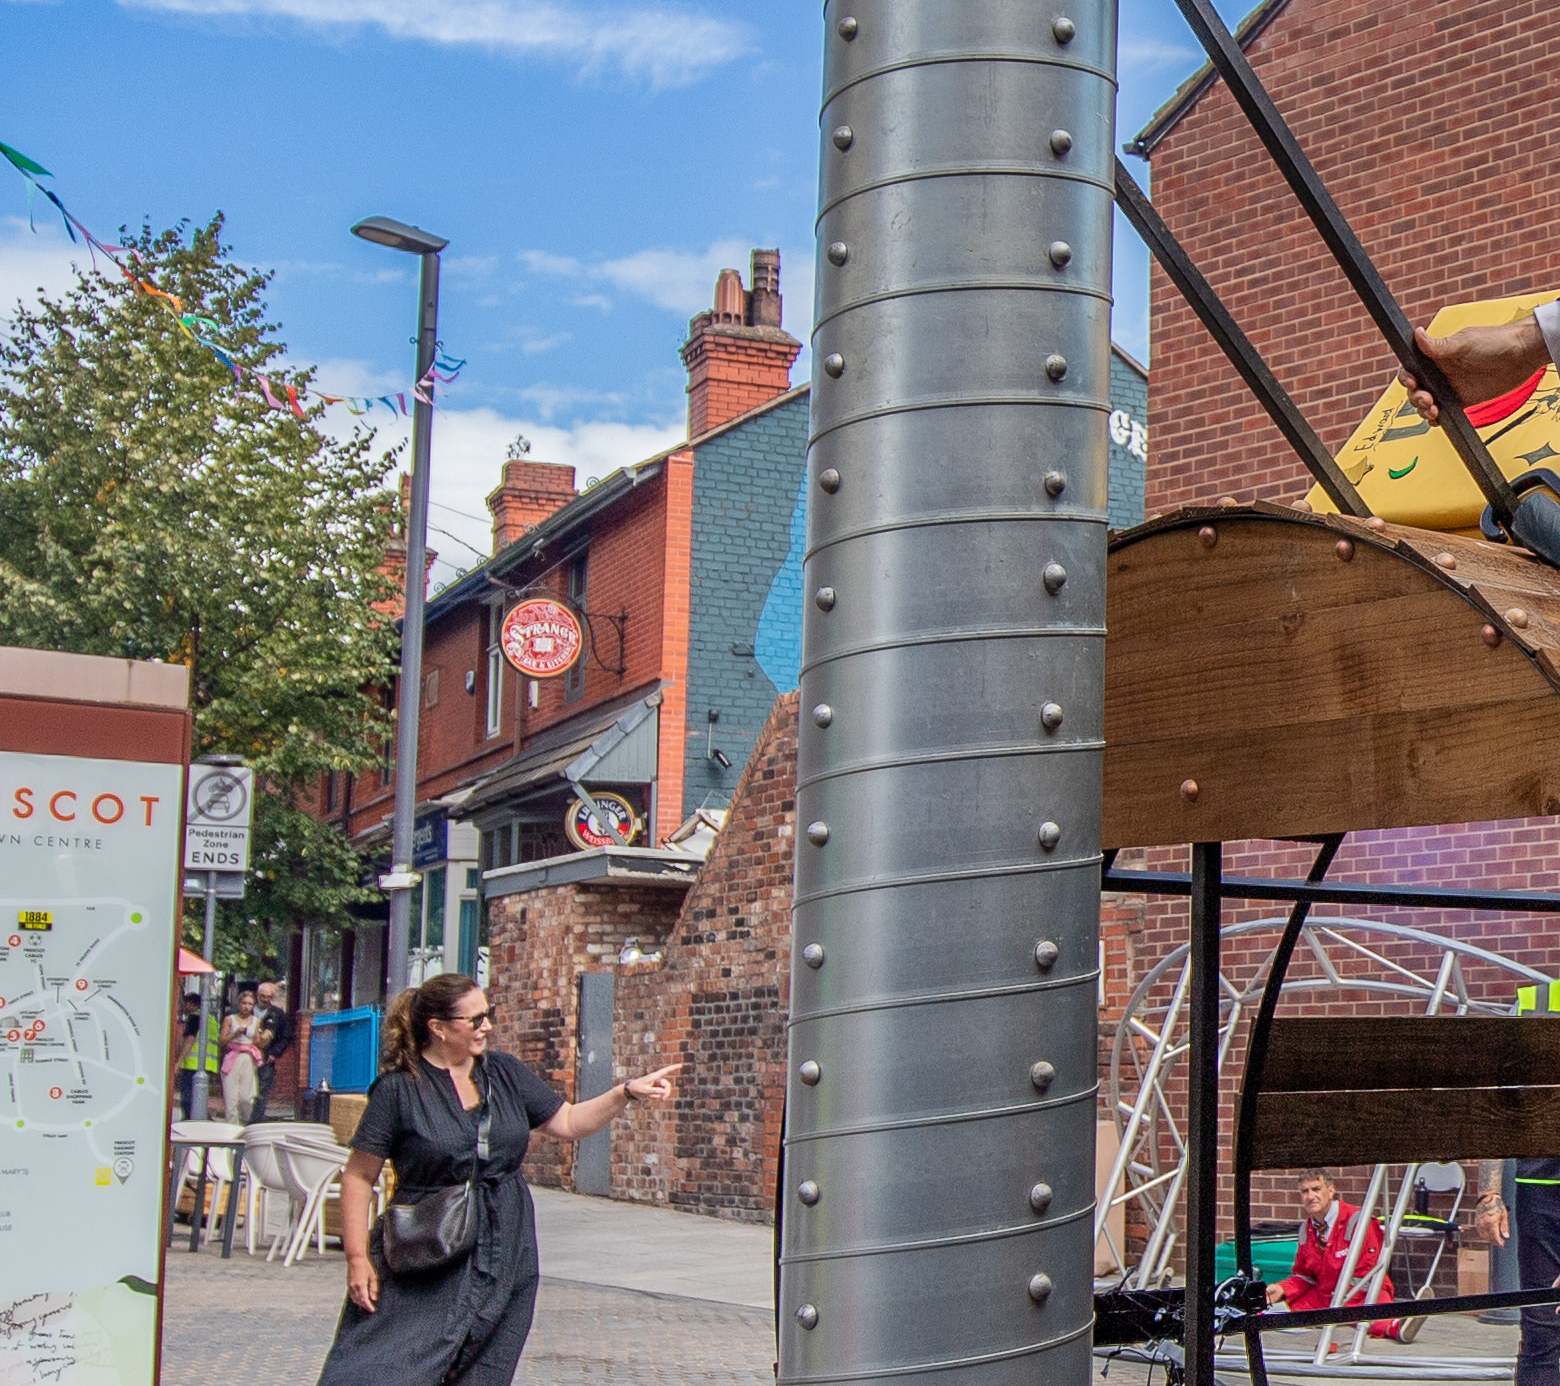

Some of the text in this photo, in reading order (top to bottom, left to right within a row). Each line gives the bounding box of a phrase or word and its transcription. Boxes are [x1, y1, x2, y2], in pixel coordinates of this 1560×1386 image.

[509, 622, 576, 645] STRANGE
[578, 800, 627, 820] ERINGER
[188, 829, 245, 839] Pedestrian
[33, 835, 103, 850] CENTRE
[202, 839, 229, 848] Zone
[192, 851, 239, 865] ENDS
[24, 911, 48, 922] 1884
